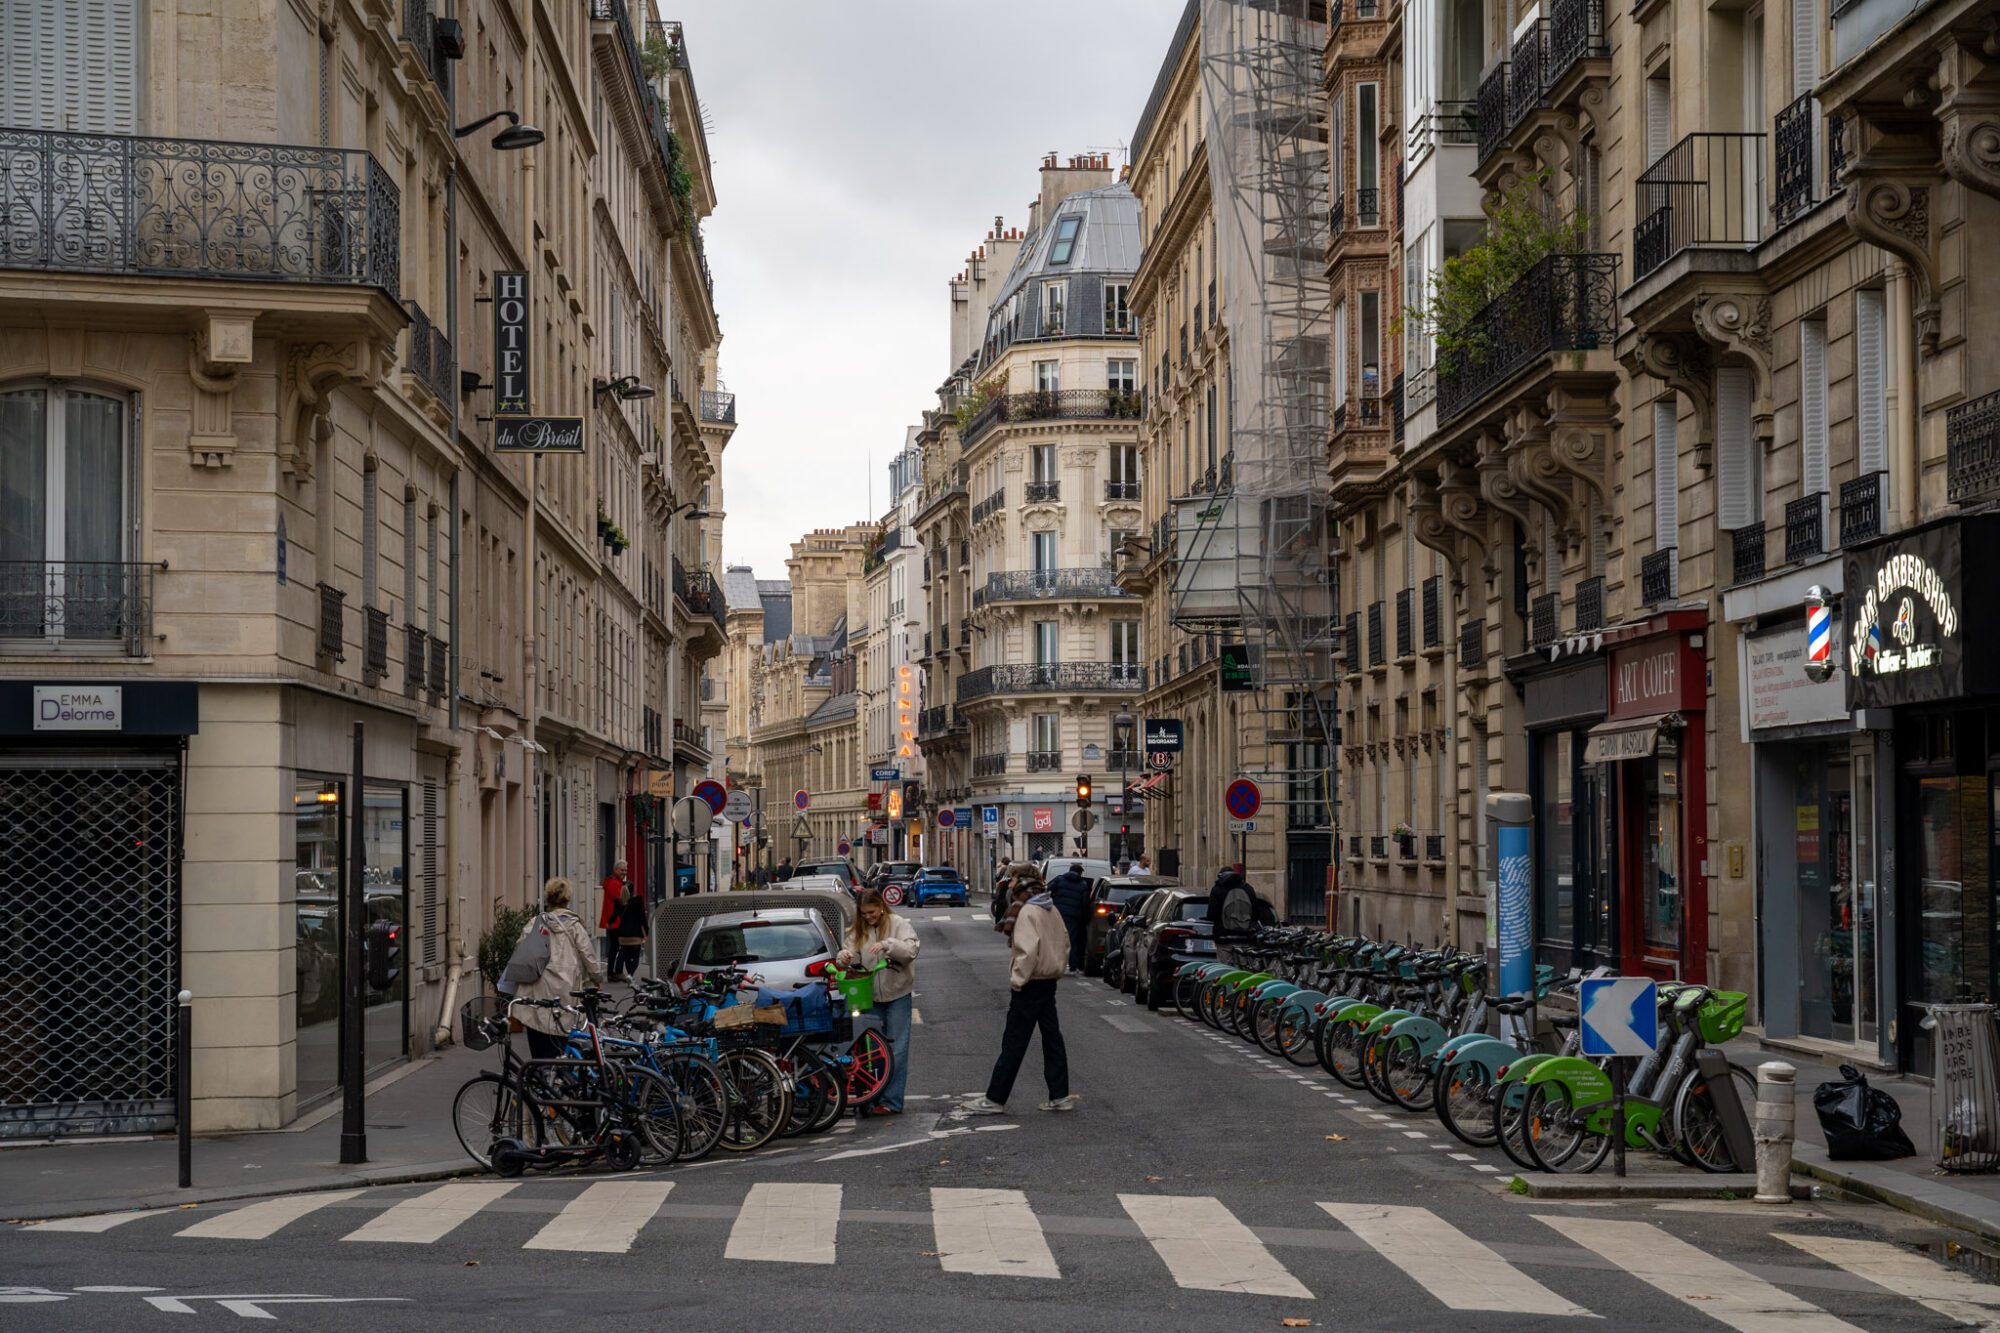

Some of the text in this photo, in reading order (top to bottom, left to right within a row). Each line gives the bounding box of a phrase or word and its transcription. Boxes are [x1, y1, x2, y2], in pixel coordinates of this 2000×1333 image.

[499, 275, 524, 398] HOTEL
[497, 420, 580, 448] du Brésil
[1877, 554, 1925, 602] BARBER
[1617, 652, 1676, 704] ART COIFF
[41, 699, 115, 721] Delorme
[60, 694, 103, 706] EMMA
[899, 665, 913, 757] CINEMA
[1156, 752, 1165, 765] B
[681, 876, 688, 887] P
